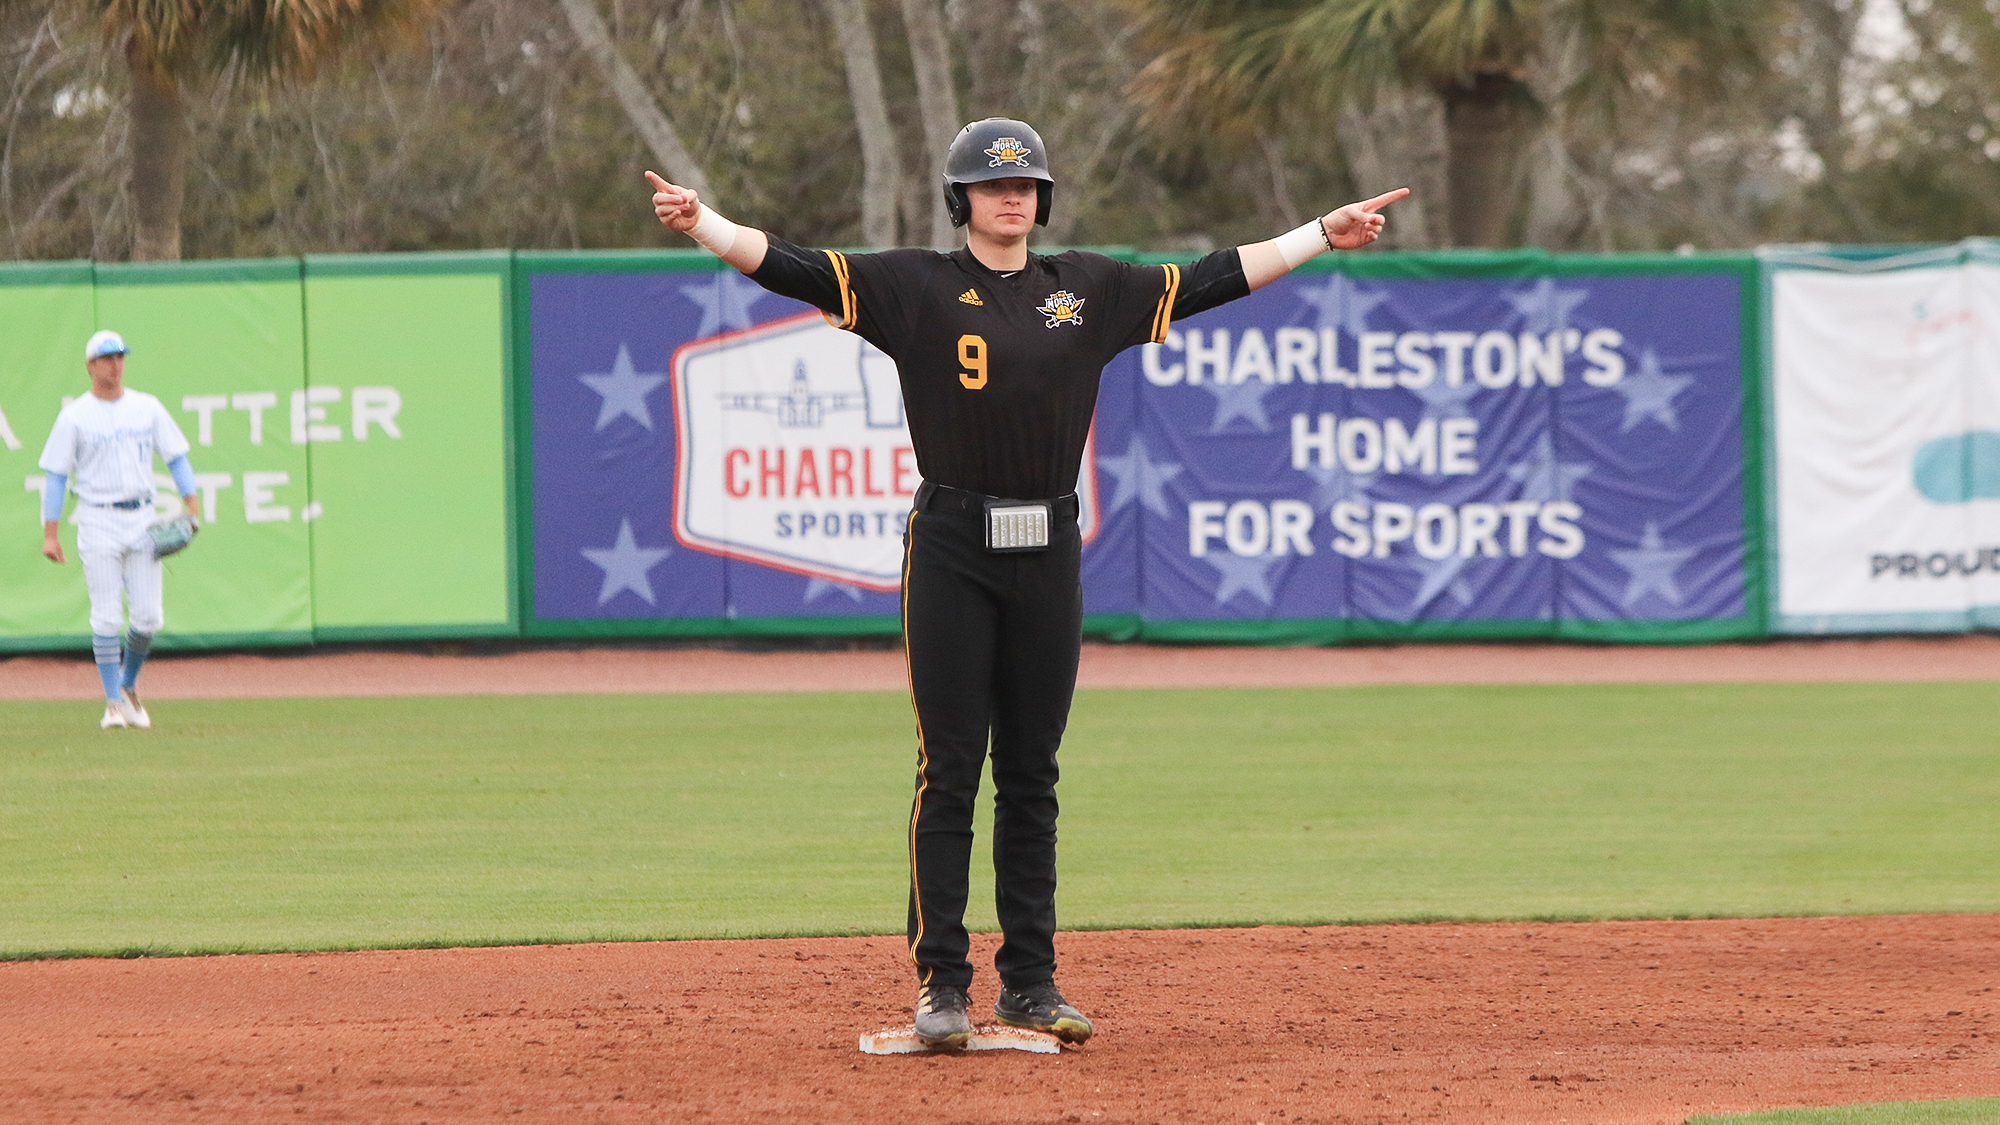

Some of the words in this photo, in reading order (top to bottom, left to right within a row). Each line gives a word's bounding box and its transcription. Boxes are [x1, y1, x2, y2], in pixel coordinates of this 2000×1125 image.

[957, 334, 988, 390] 9
[1141, 326, 1626, 389] CHARLESTON'S
[61, 386, 401, 448] TTER
[1291, 412, 1480, 475] HOME
[1187, 500, 1315, 558] FOR
[1330, 500, 1586, 559] SPORTS
